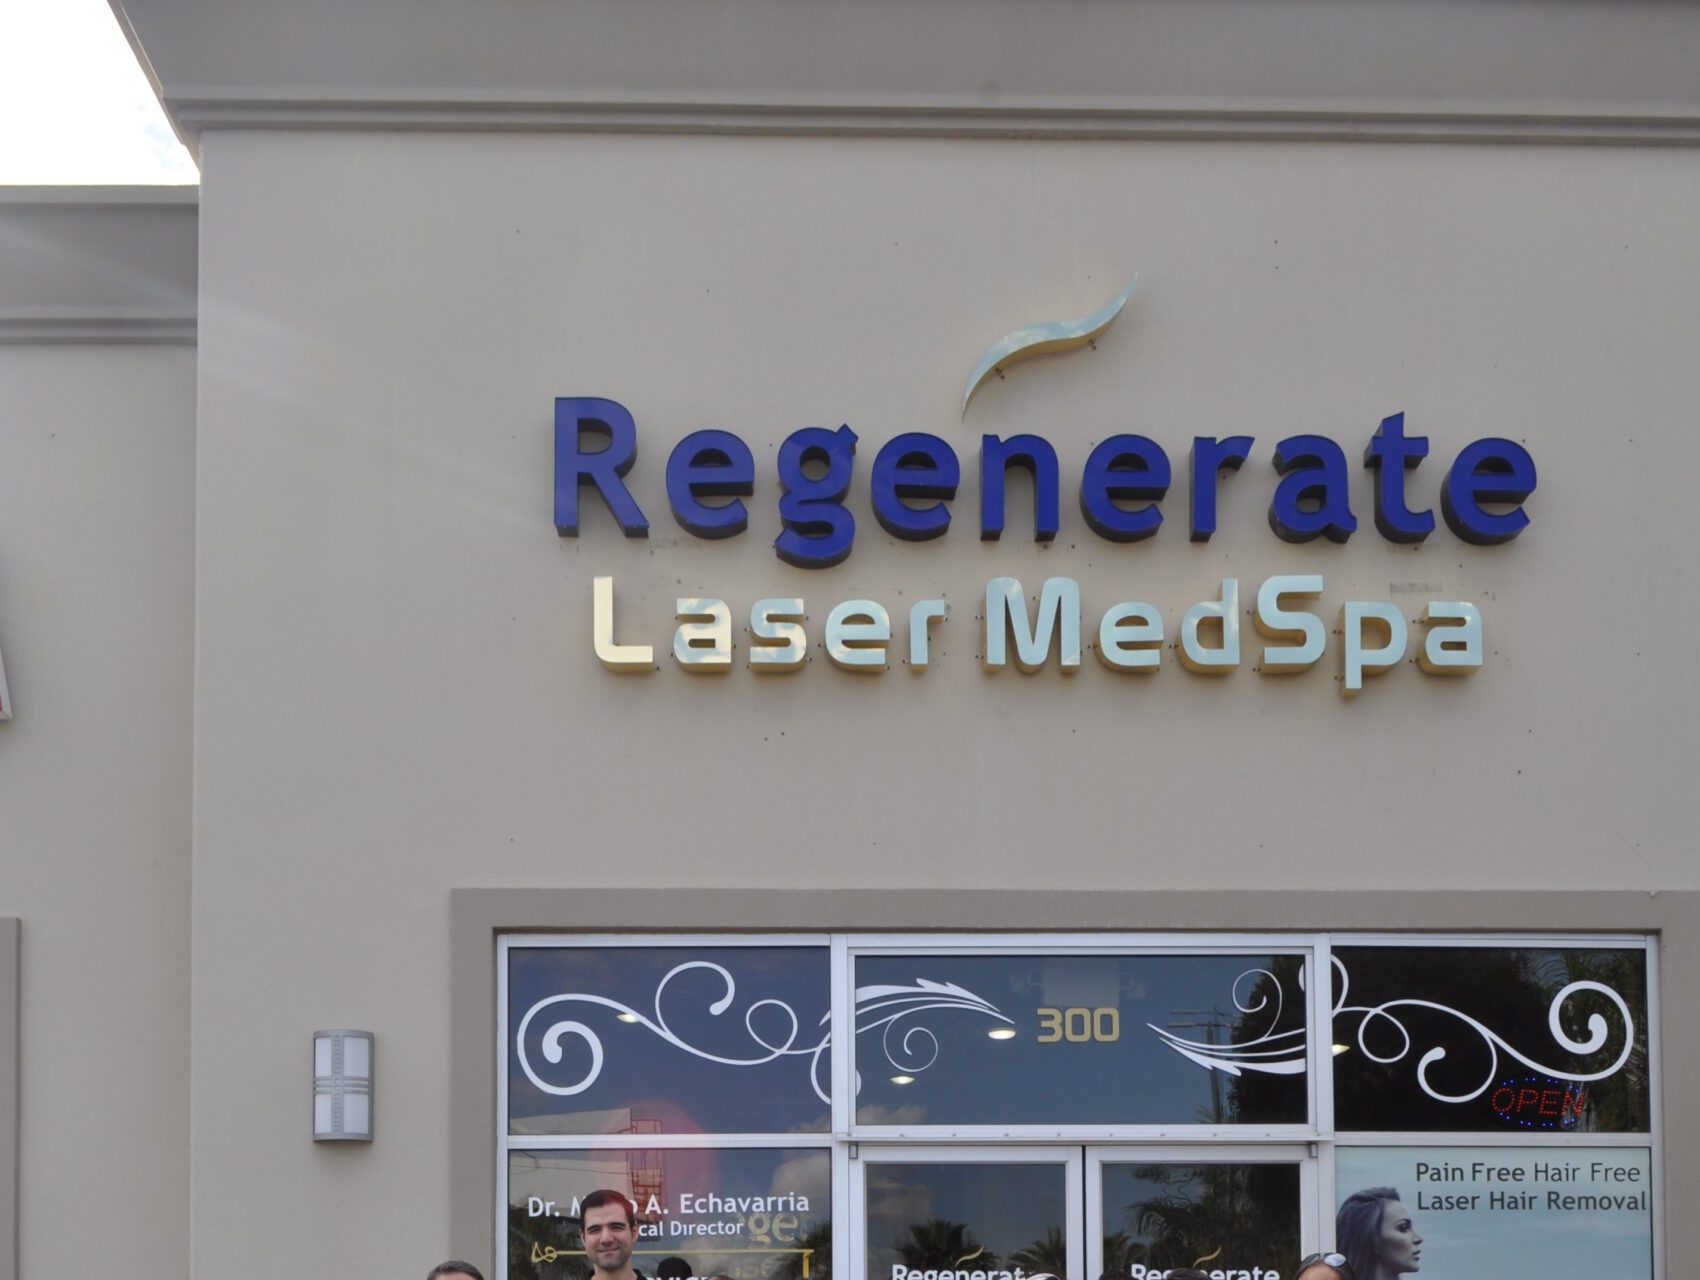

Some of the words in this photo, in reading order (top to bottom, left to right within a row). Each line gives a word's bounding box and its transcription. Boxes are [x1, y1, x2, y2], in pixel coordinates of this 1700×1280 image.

[554, 396, 1537, 568] Regenerate
[593, 576, 945, 671] Laser
[983, 575, 1483, 697] MedSpa
[1037, 1007, 1119, 1042] 300
[1490, 1087, 1586, 1116] OPEN
[1416, 1162, 1464, 1182] Pain
[1472, 1162, 1525, 1182] Free
[1534, 1162, 1581, 1182] Hair
[1591, 1163, 1641, 1182] Free
[528, 1197, 560, 1217] Dr.
[645, 1195, 669, 1215] A.
[680, 1191, 810, 1214] Echavarria
[1417, 1191, 1481, 1211] Laser
[1490, 1191, 1538, 1211] Hair
[1547, 1191, 1647, 1211] Removal
[670, 1220, 744, 1236] Director
